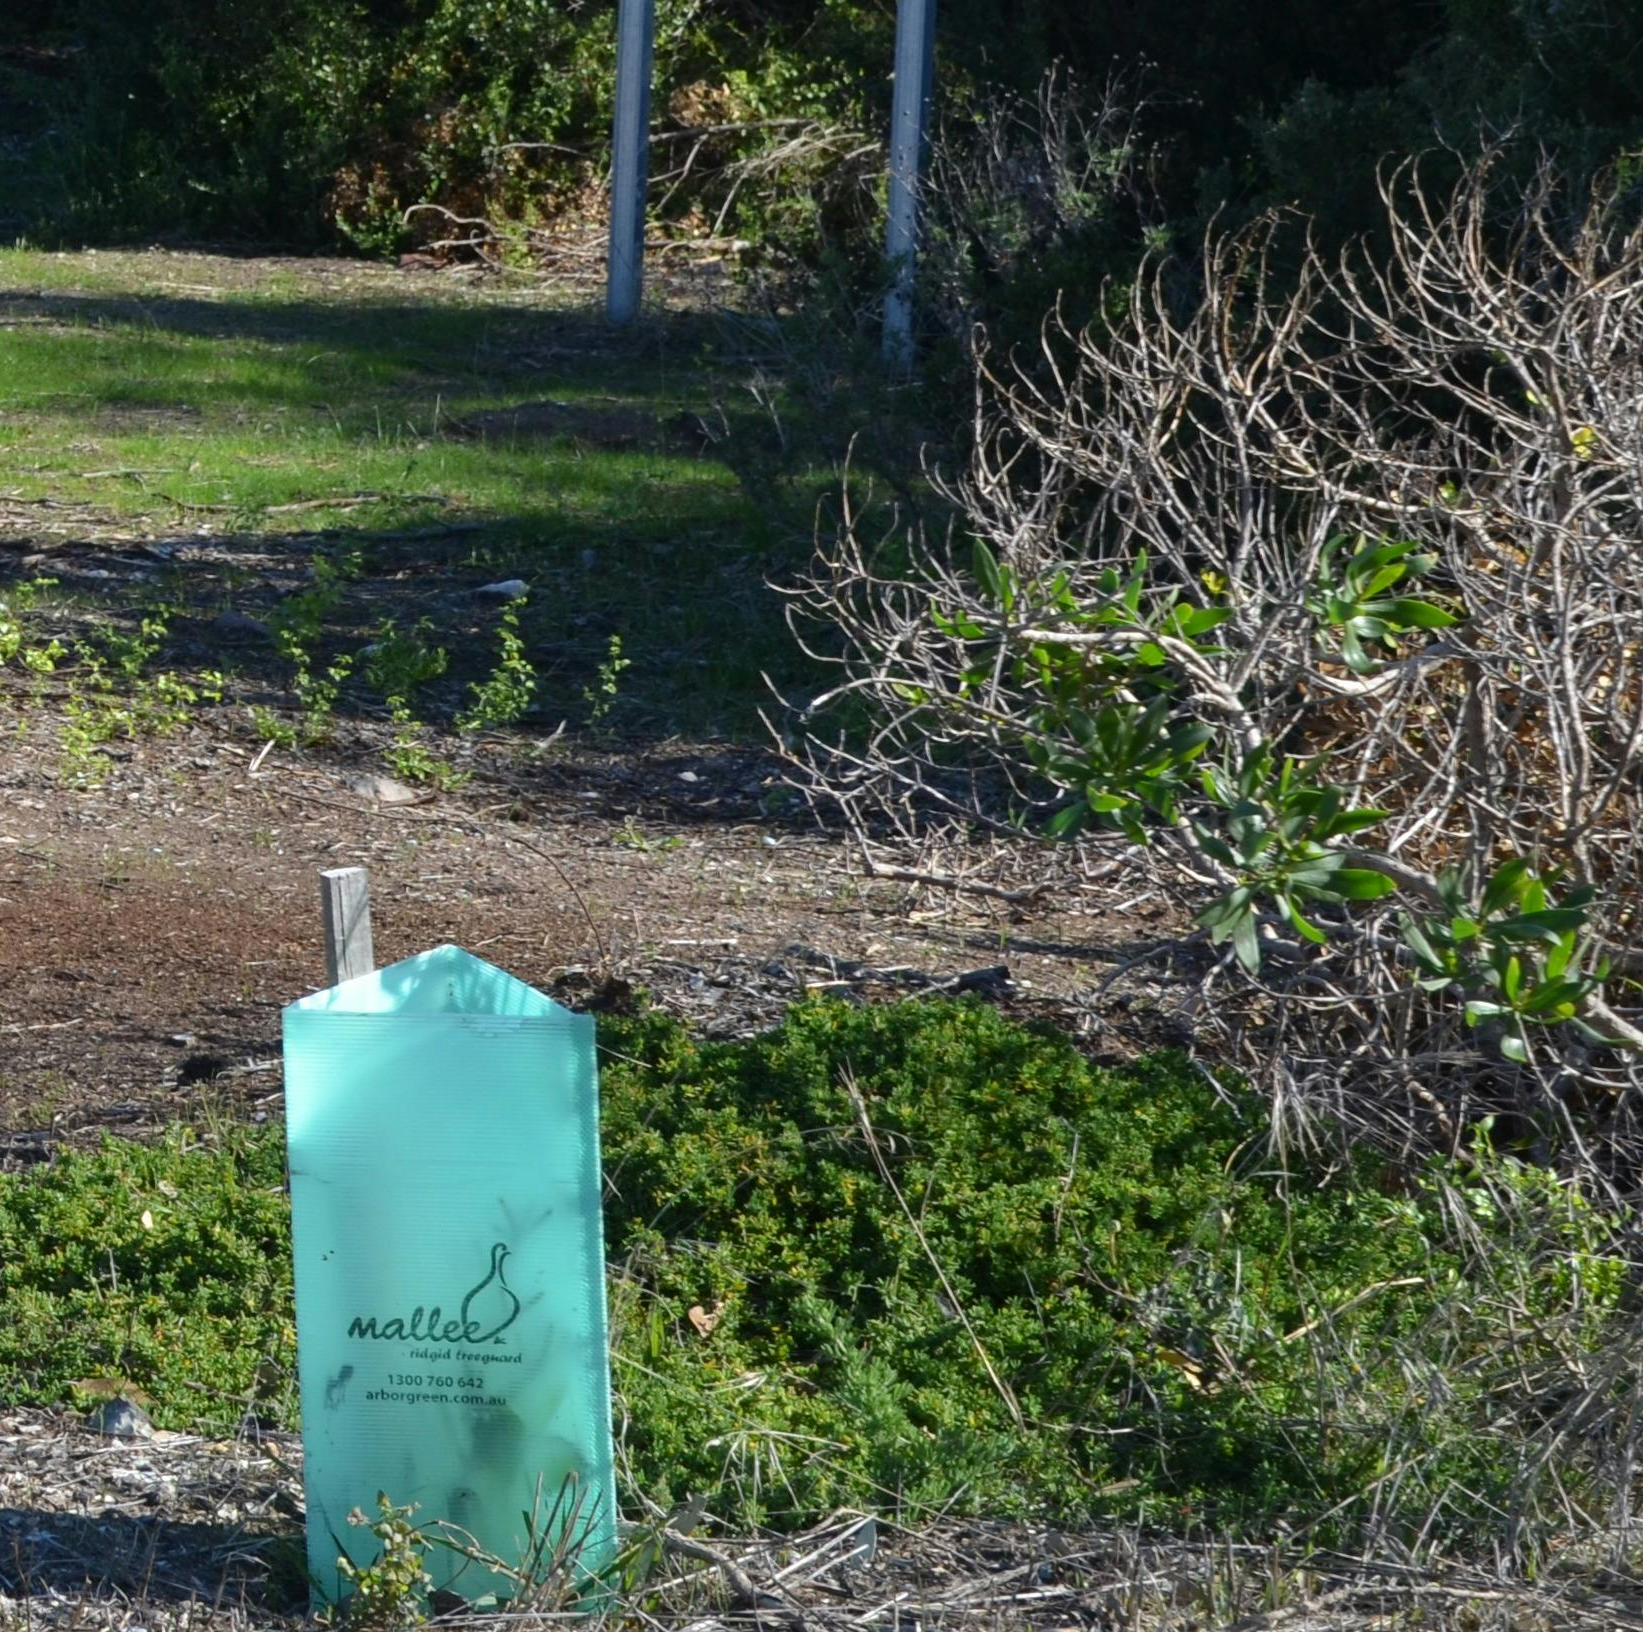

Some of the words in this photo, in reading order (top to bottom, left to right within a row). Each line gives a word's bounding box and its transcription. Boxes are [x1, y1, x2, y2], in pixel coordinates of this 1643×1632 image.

[410, 1348, 451, 1362] ridgid
[455, 1350, 522, 1365] treeguard
[388, 1374, 423, 1387] 1300
[427, 1375, 454, 1388] 760
[457, 1377, 484, 1389] 642
[365, 1387, 507, 1406] arborgreen.com.au
